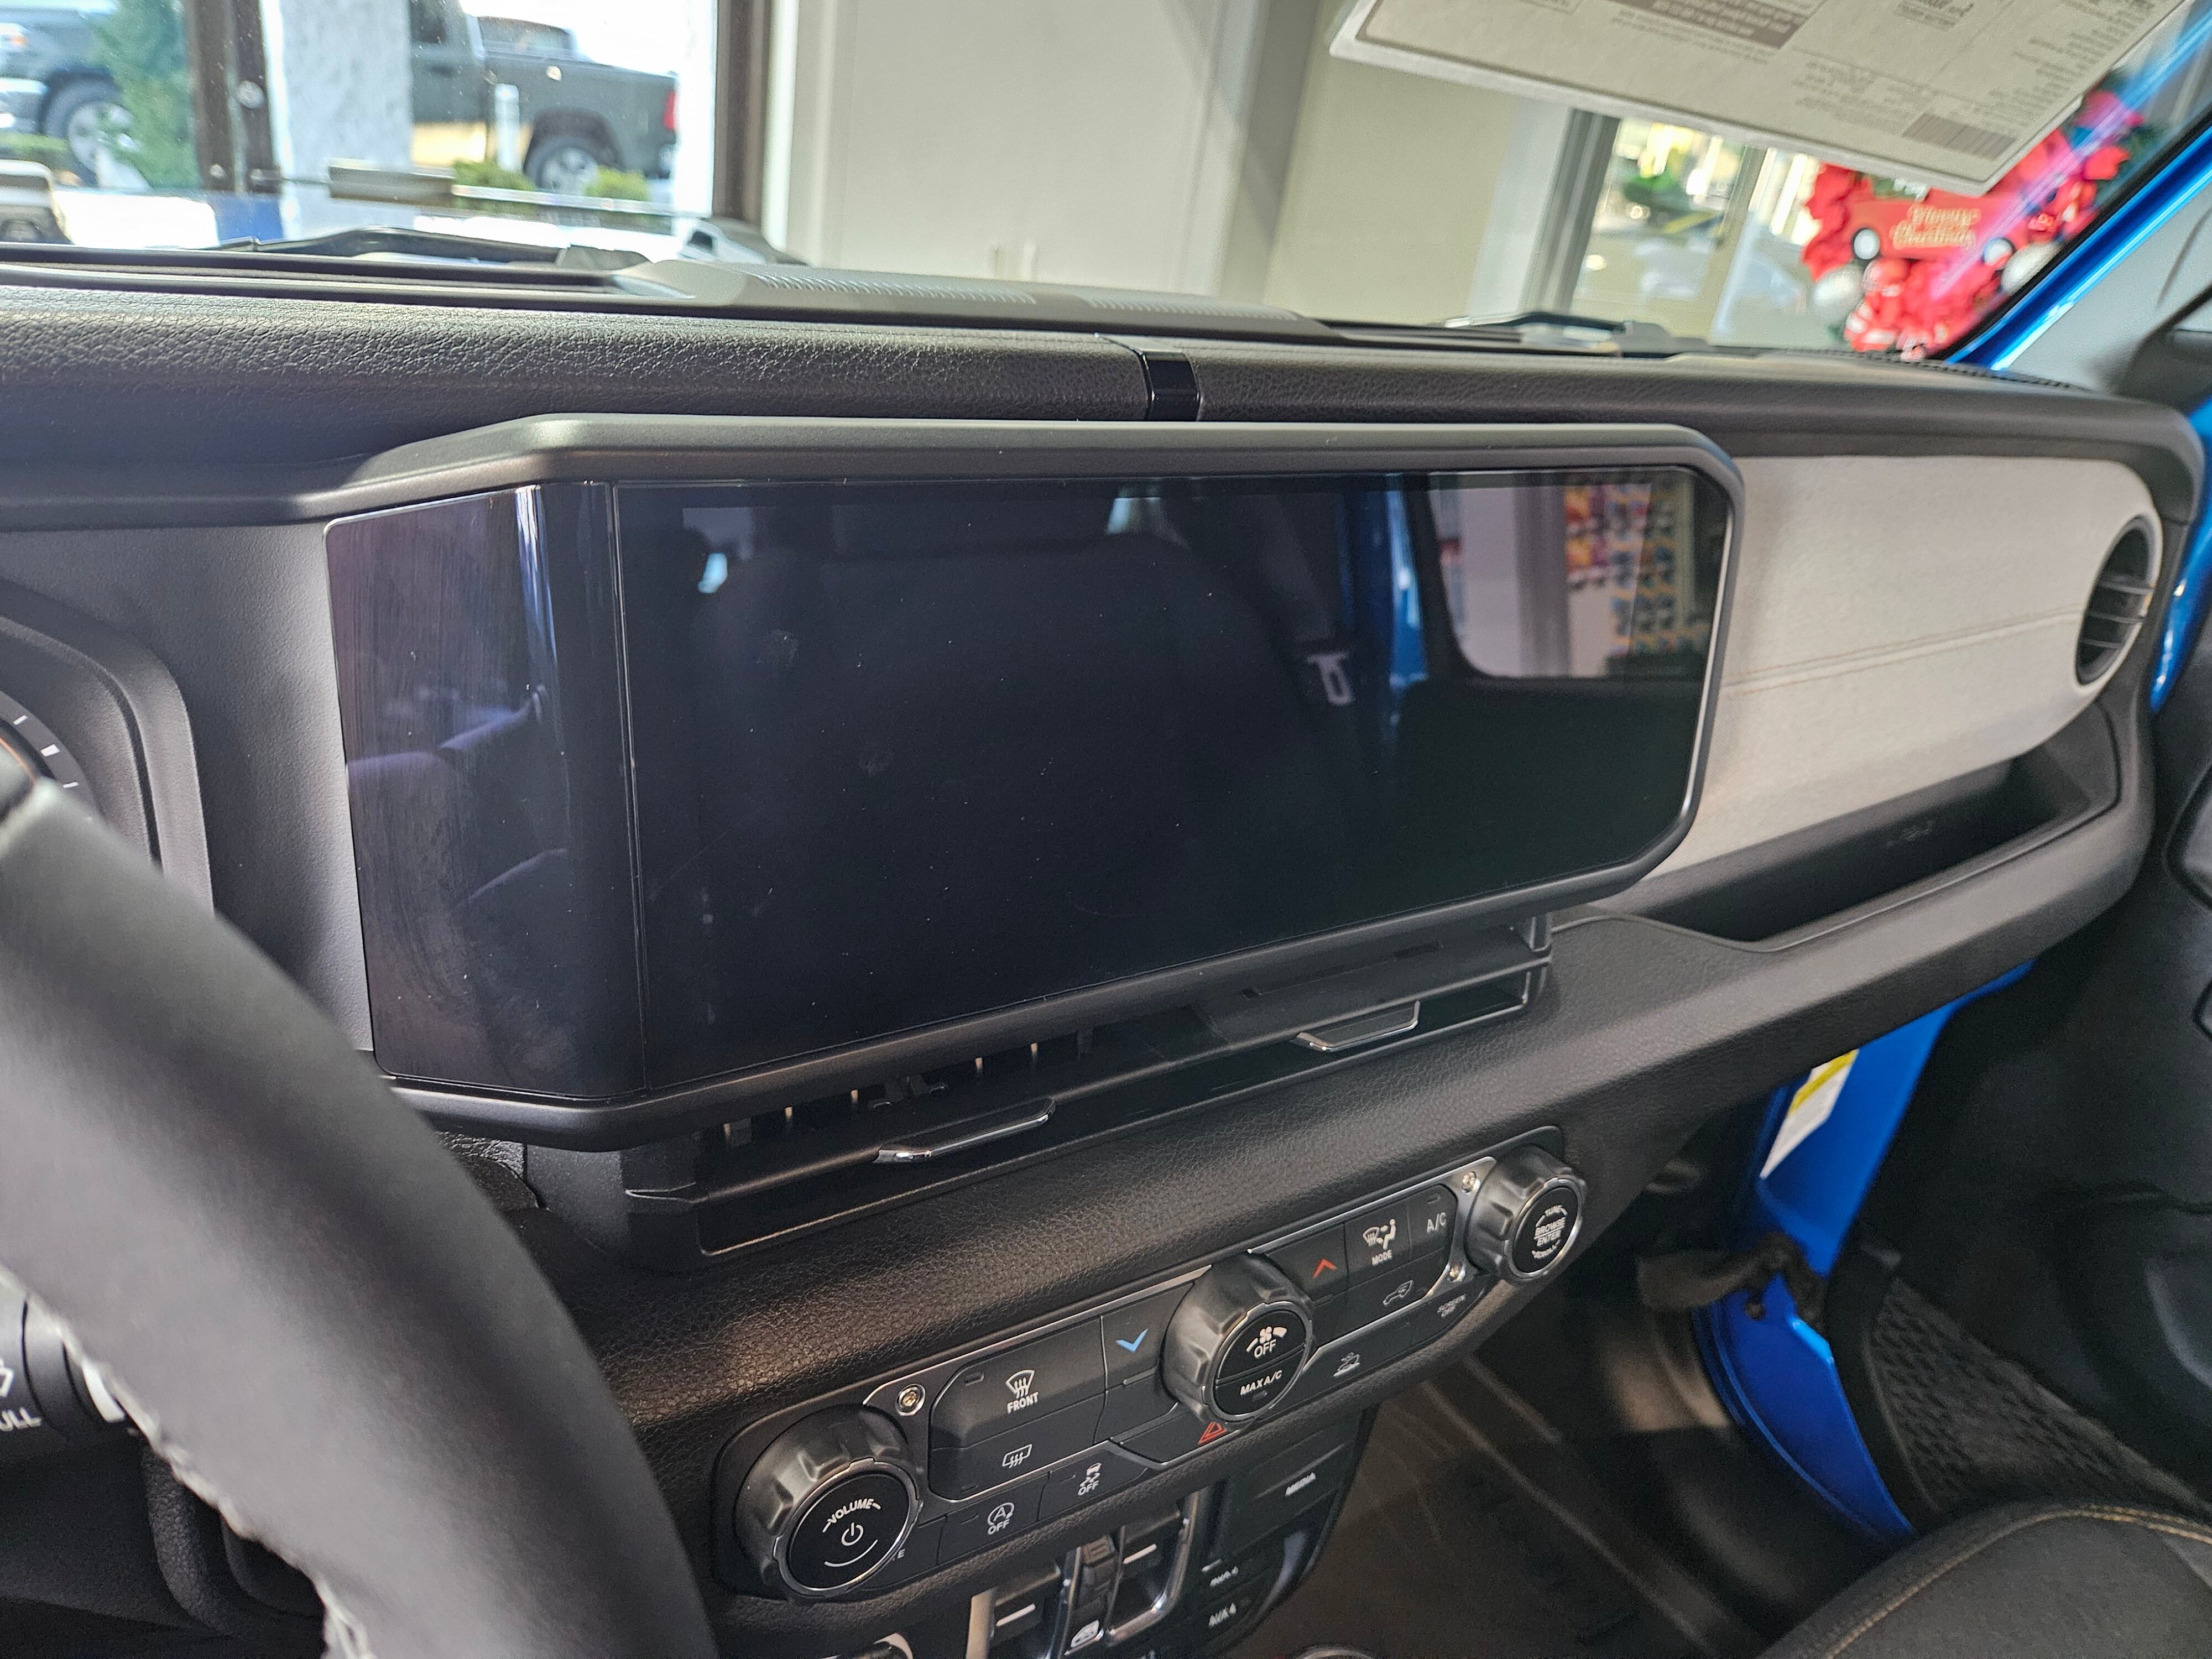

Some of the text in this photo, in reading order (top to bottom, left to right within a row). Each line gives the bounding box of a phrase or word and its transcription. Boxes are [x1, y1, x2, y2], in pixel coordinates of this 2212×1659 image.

[1427, 1212, 1447, 1233] A/C
[1535, 1217, 1566, 1237] BROWSE
[1537, 1229, 1562, 1246] ENTER
[1371, 1249, 1393, 1266] MODE
[1254, 1339, 1277, 1358] OFF
[1240, 1370, 1283, 1395] MAX A/C
[1006, 1391, 1039, 1413] FRONT
[0, 1406, 42, 1431] ULL
[1078, 1480, 1099, 1495] OFF
[827, 1498, 874, 1524] VOLUME
[987, 1519, 1010, 1535] OFF
